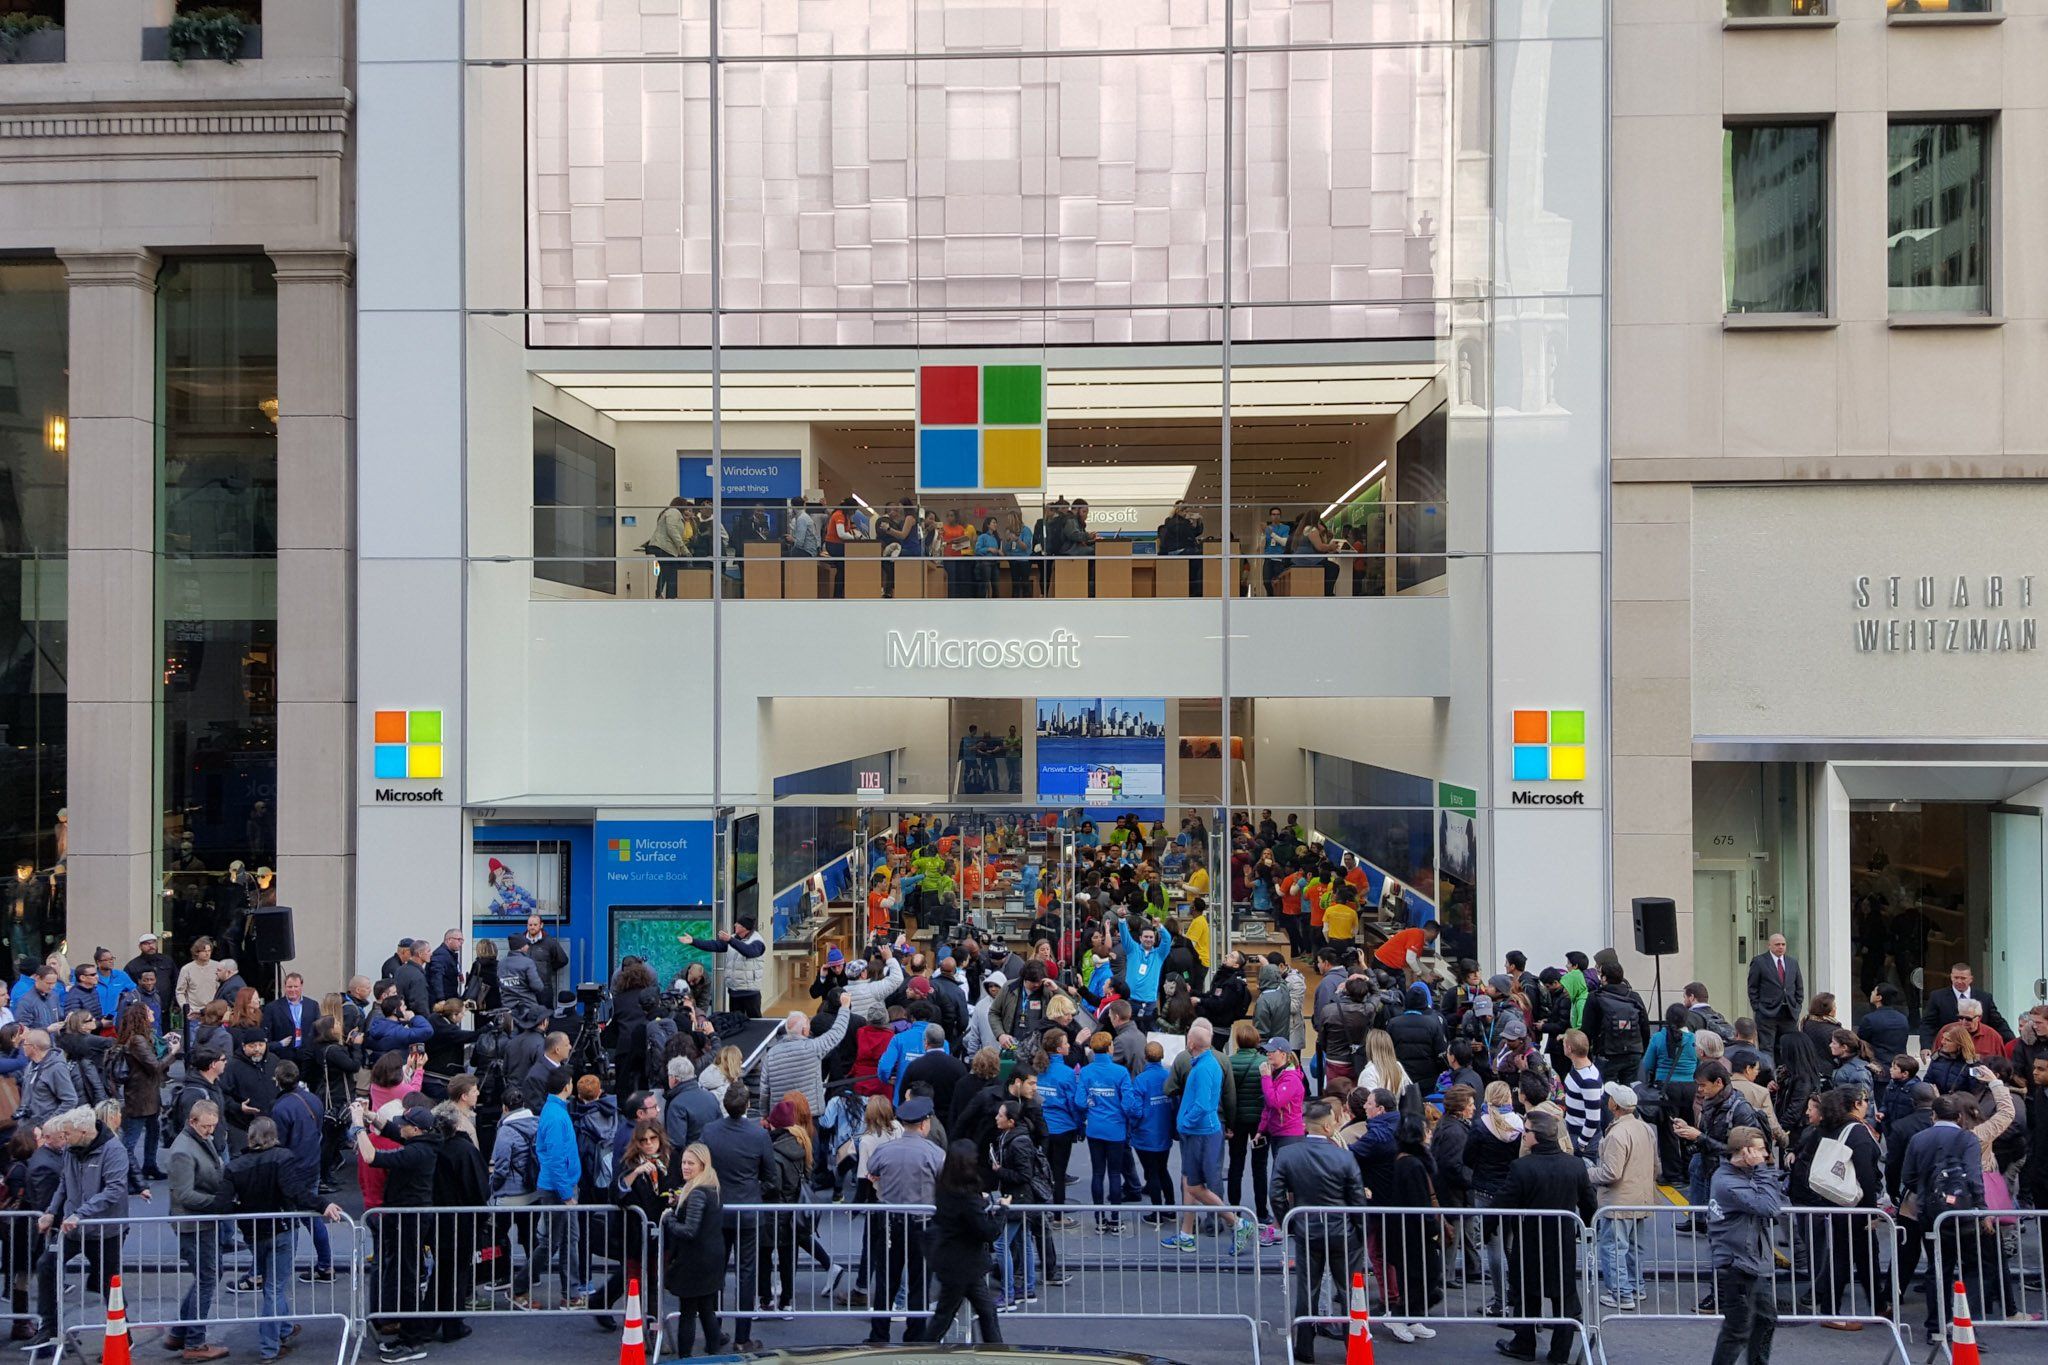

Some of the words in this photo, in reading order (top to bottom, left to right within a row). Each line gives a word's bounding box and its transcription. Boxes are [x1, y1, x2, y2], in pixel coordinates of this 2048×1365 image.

[723, 466, 767, 476] Windows
[768, 466, 778, 476] 10
[726, 485, 746, 494] great
[747, 483, 769, 494] things
[1087, 506, 1138, 523] crosoft
[1856, 575, 2035, 608] STUART
[1858, 618, 2037, 651] WEITZMAN
[886, 627, 1081, 669] Microsoft
[1042, 765, 1067, 773] Answer
[1068, 765, 1086, 773] Desk
[375, 787, 444, 802] Microsoft
[1511, 790, 1585, 805] Microsoft
[635, 838, 688, 849] Microsoft
[1713, 835, 1735, 846] 675
[635, 851, 677, 862] Surface
[607, 871, 629, 881] New
[630, 871, 664, 881] Surface
[665, 871, 689, 881] Book
